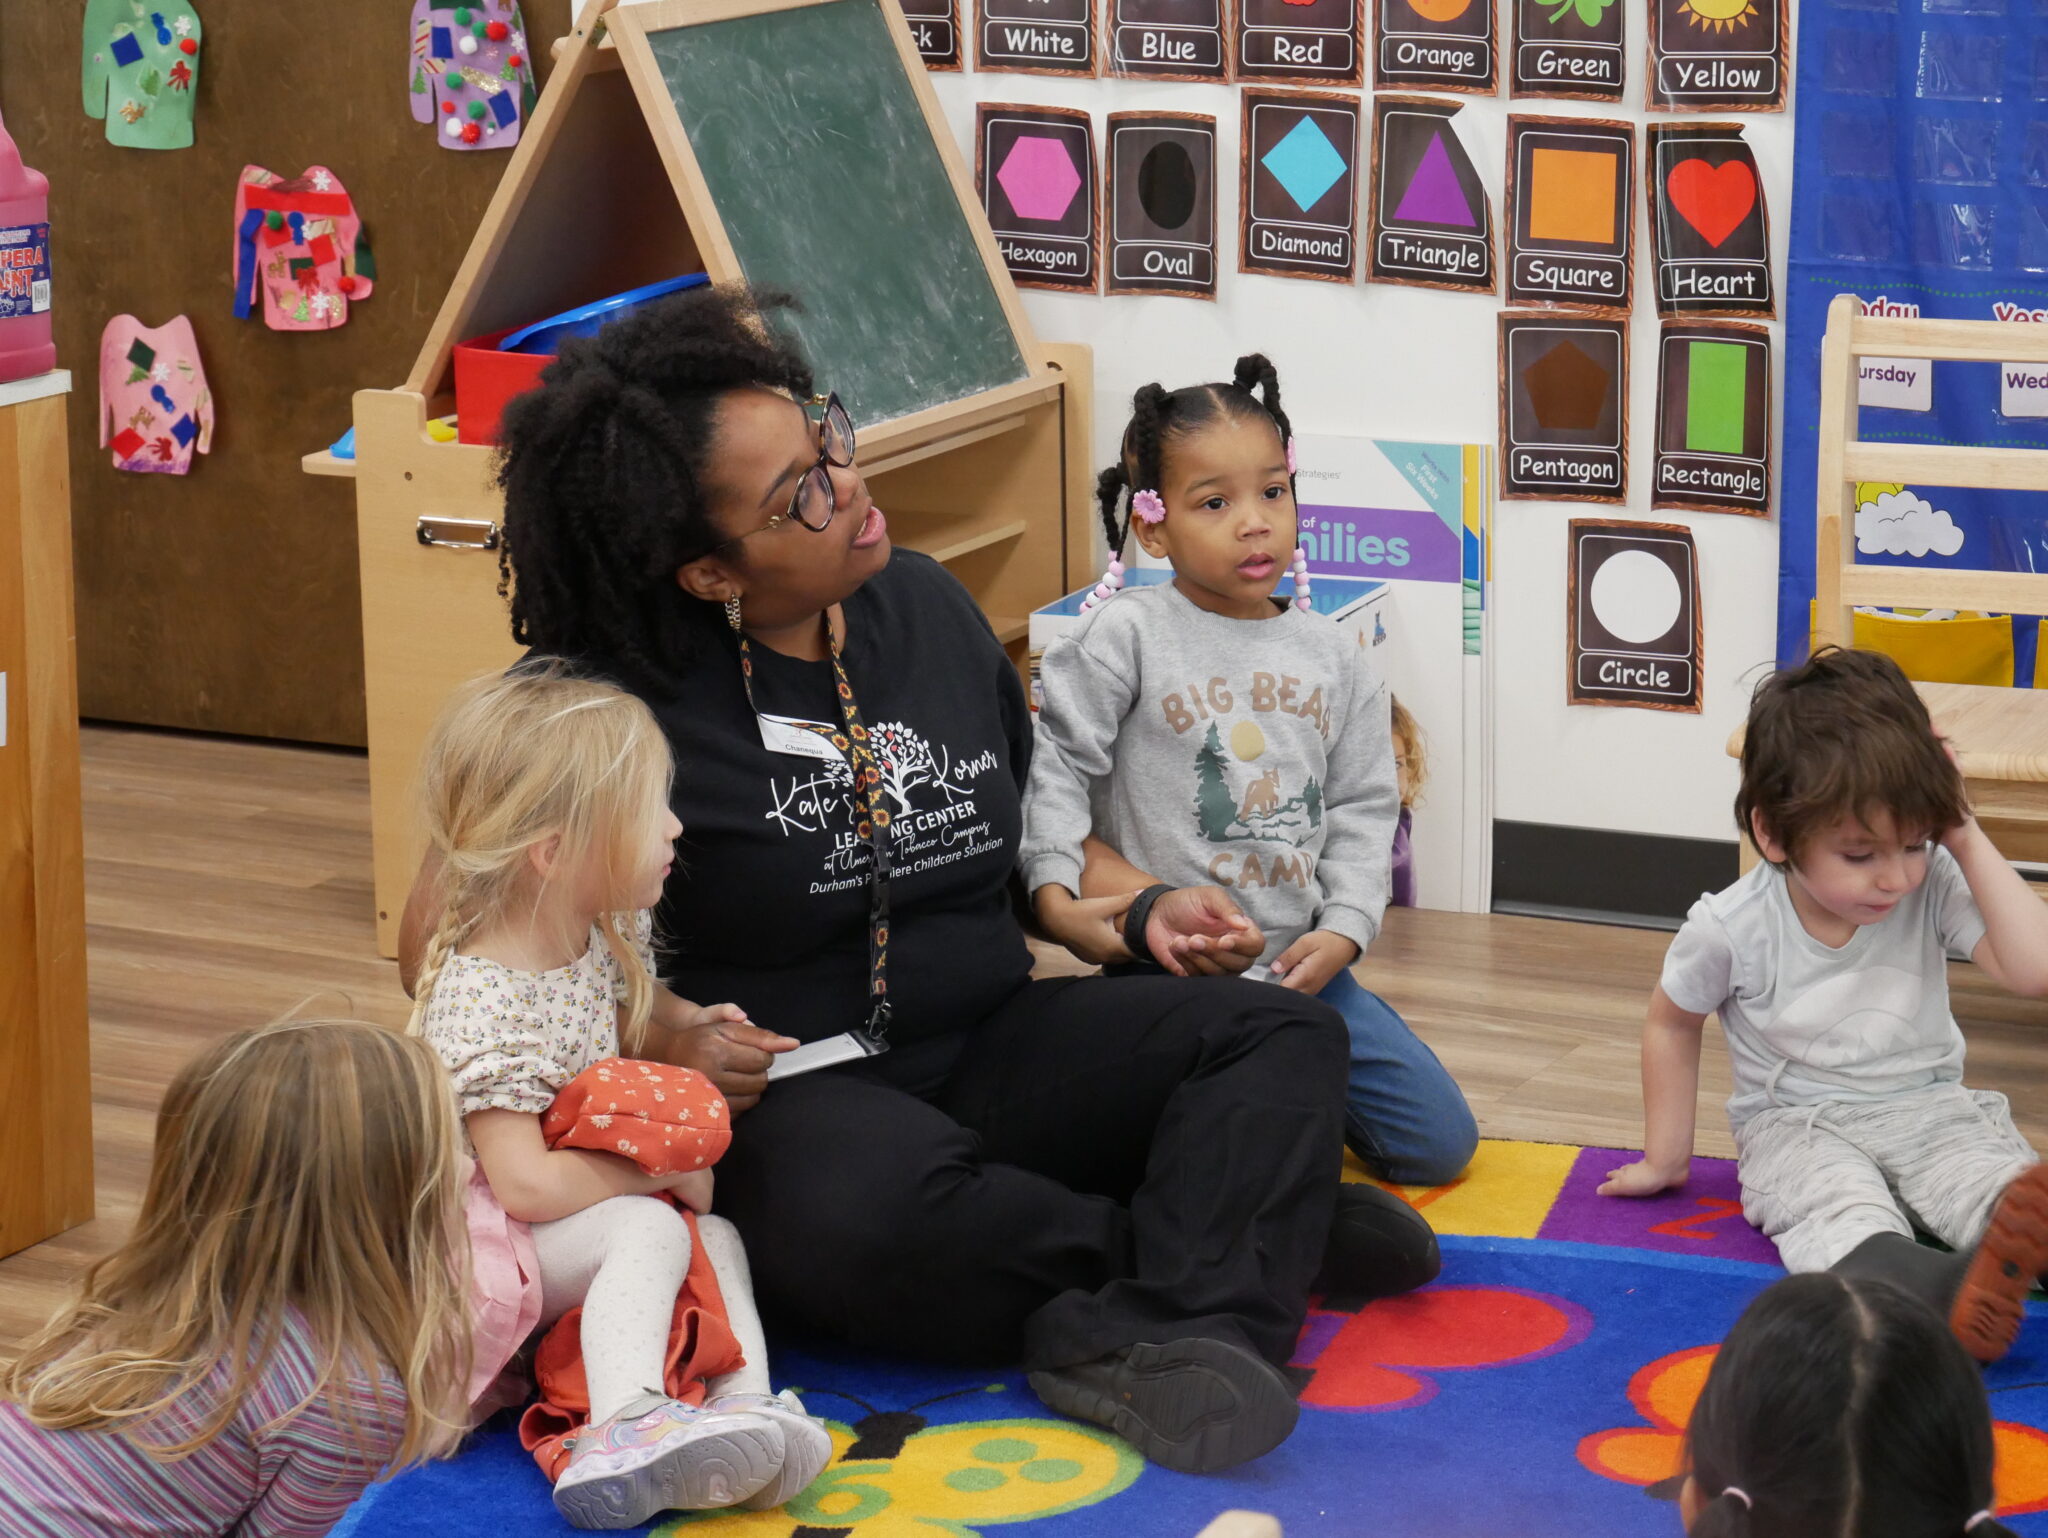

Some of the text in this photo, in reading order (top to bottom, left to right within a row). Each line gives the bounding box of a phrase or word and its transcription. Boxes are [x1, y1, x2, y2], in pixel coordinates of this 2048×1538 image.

[1004, 27, 1075, 54] White
[1142, 32, 1197, 60] Blue
[1274, 37, 1324, 63] Red
[1397, 43, 1476, 73] Orange
[1537, 50, 1611, 78] Green
[1676, 62, 1761, 88] Yellow
[999, 241, 1077, 269] Hexagon
[1261, 229, 1343, 258] Diamond
[1387, 238, 1480, 272] Triangle
[1143, 250, 1194, 276] Oval
[1527, 260, 1614, 290] Square
[1674, 269, 1756, 295] Heart
[1519, 455, 1614, 484] Pentagon
[1662, 463, 1762, 493] Rectangle
[1302, 516, 1316, 529] of
[1599, 660, 1671, 688] Circle
[1161, 676, 1234, 735] BIG
[926, 743, 998, 804] Korner
[916, 800, 977, 831] CENTER
[893, 832, 939, 861] Tobacco
[940, 821, 991, 847] Campus
[809, 875, 863, 894] Durham's
[914, 850, 962, 873] Childcare
[963, 837, 1004, 858] Solution
